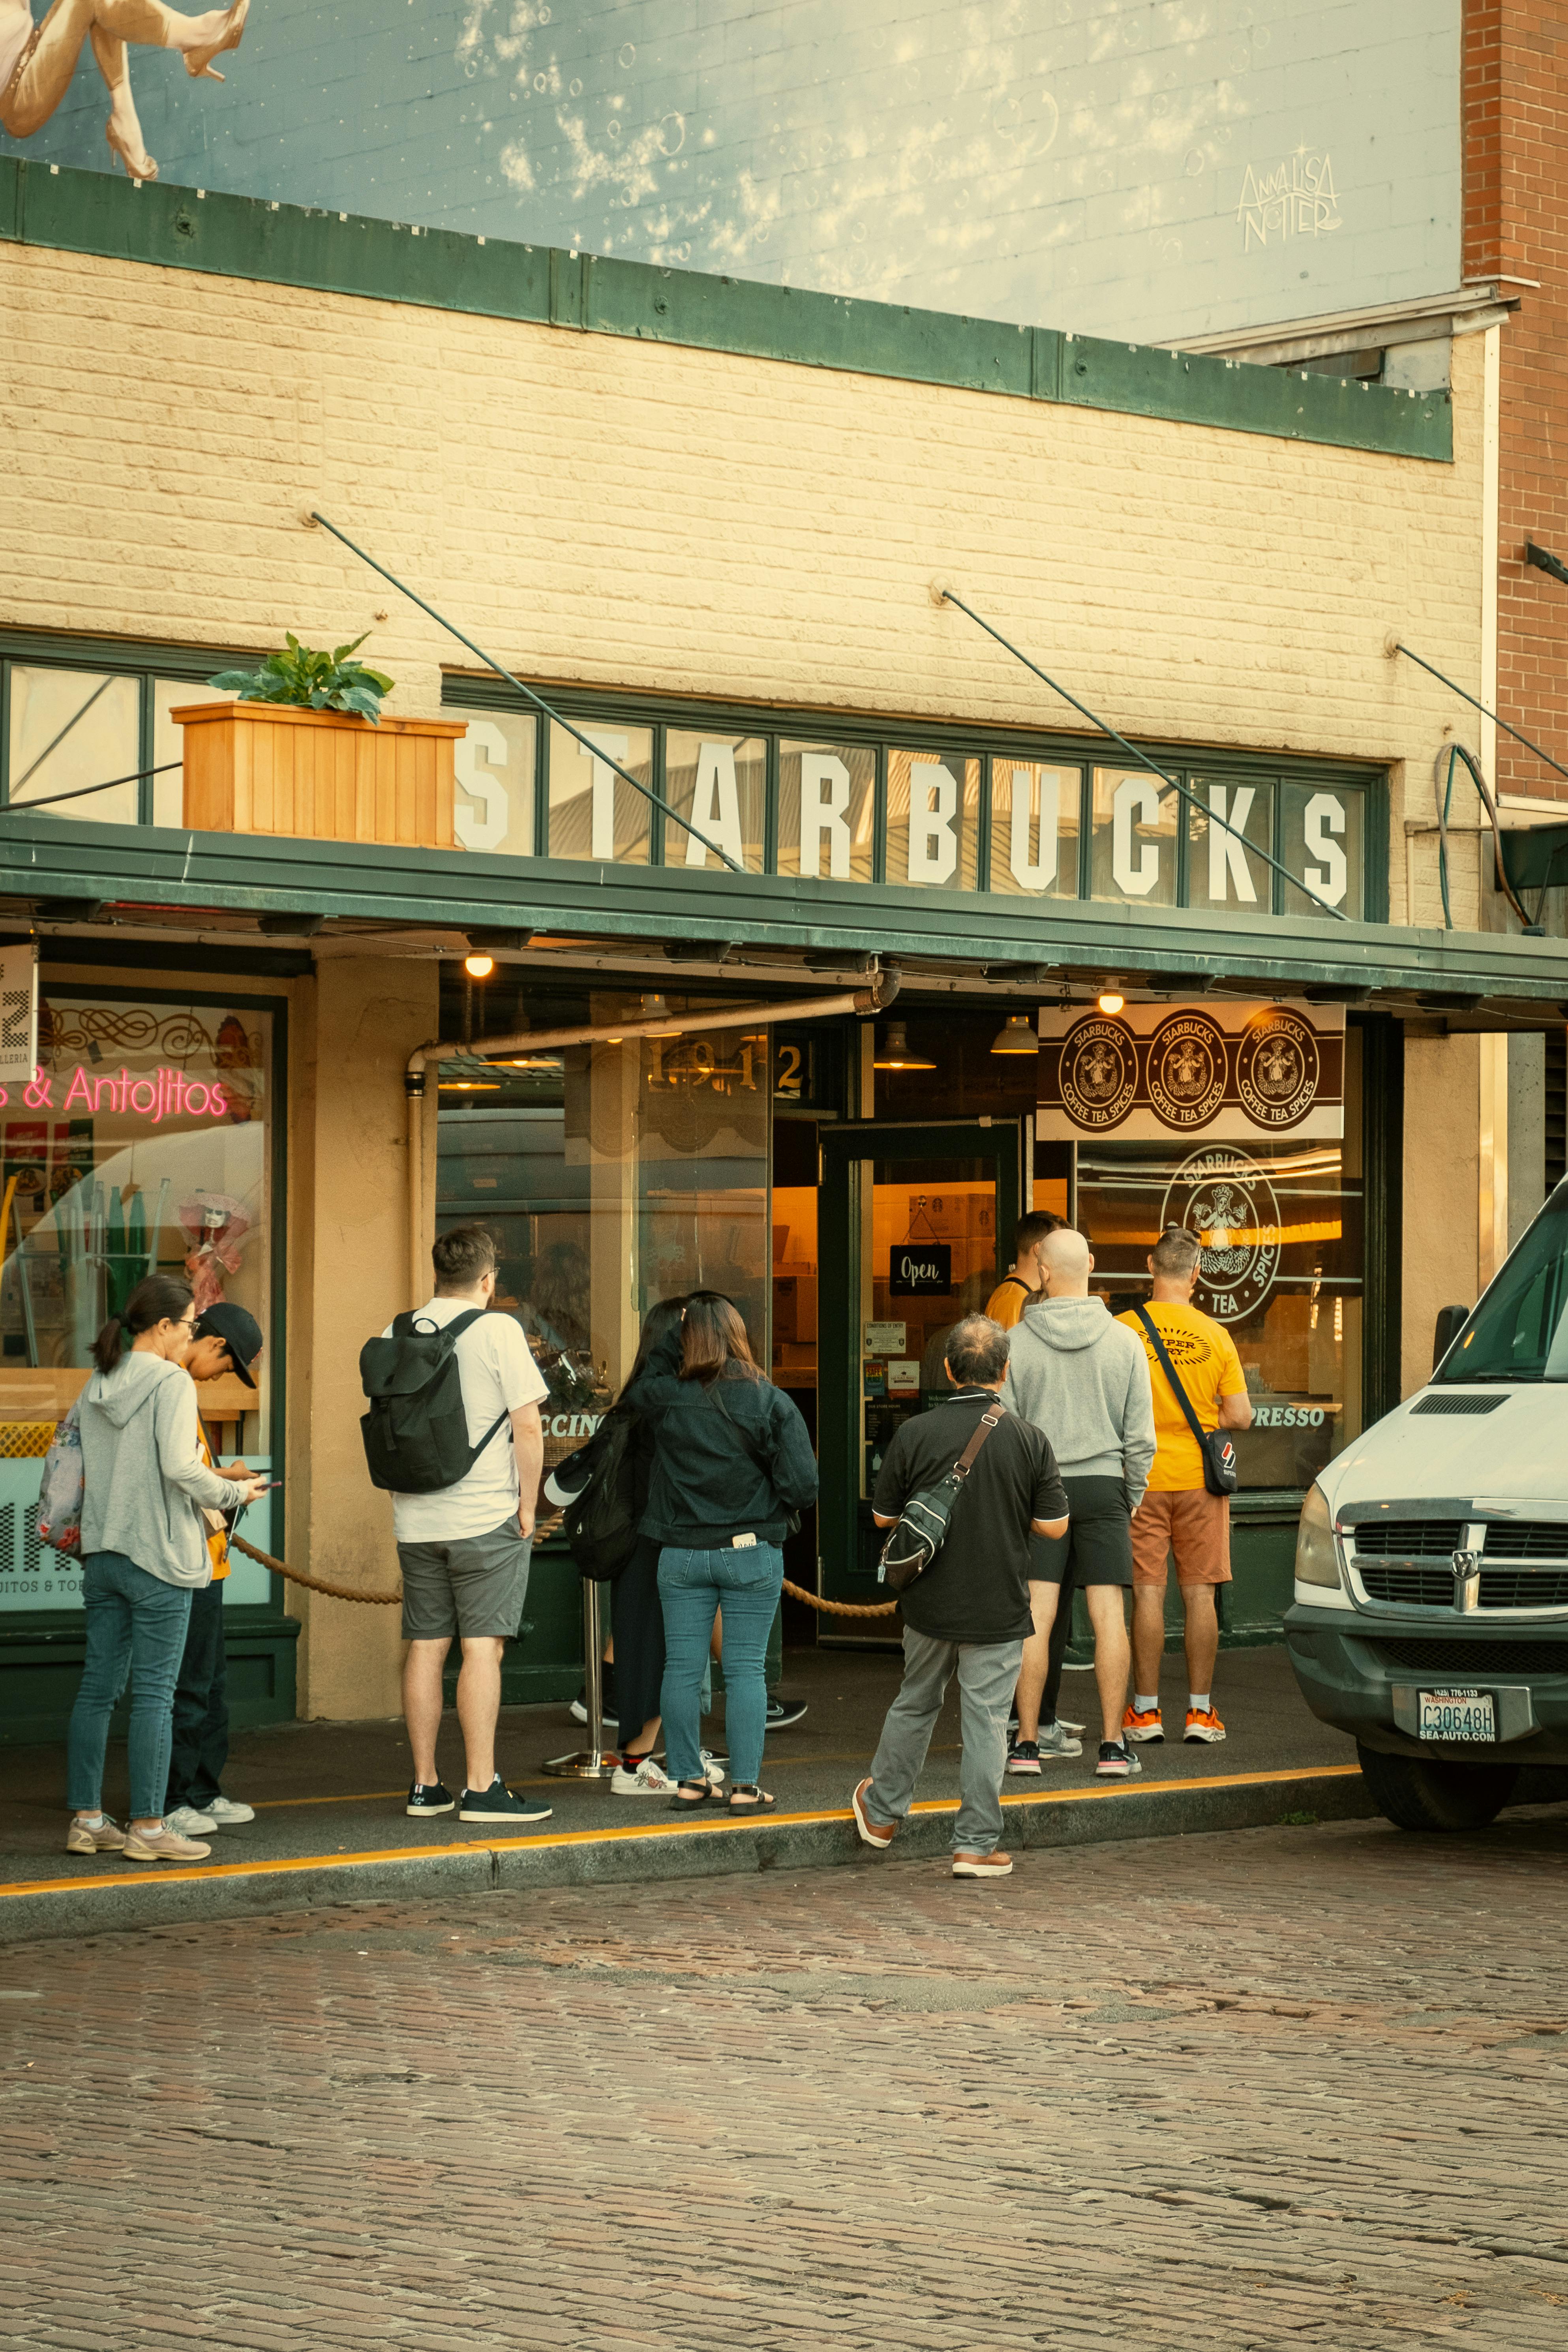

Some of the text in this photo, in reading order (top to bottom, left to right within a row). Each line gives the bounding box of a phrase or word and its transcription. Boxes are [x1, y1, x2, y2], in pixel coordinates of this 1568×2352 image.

[1244, 192, 1343, 252] NOTTER
[454, 719, 1347, 907] STARBUCKS
[1074, 1024, 1125, 1047] STARBUCKS
[1162, 1022, 1214, 1045] STARBUCKS
[1252, 1019, 1305, 1043] STARBUCKS
[64, 1067, 227, 1123] Antojitos
[1064, 1082, 1133, 1122] COFFEE TEA SPICES
[1152, 1081, 1222, 1121] COFFEE TEA SPICES
[1242, 1079, 1314, 1120] COFFEE TEA SPICES
[1184, 1153, 1257, 1191] STARBUCKS
[901, 1256, 939, 1287] Open
[1212, 1224, 1275, 1313] TEA SPICES
[1146, 1337, 1196, 1349] SPER
[540, 1414, 606, 1437] CCIN
[44, 1580, 53, 1592] &
[1424, 1706, 1492, 1731] C30648H
[1420, 1731, 1495, 1742] SEA-AUTO.COM
